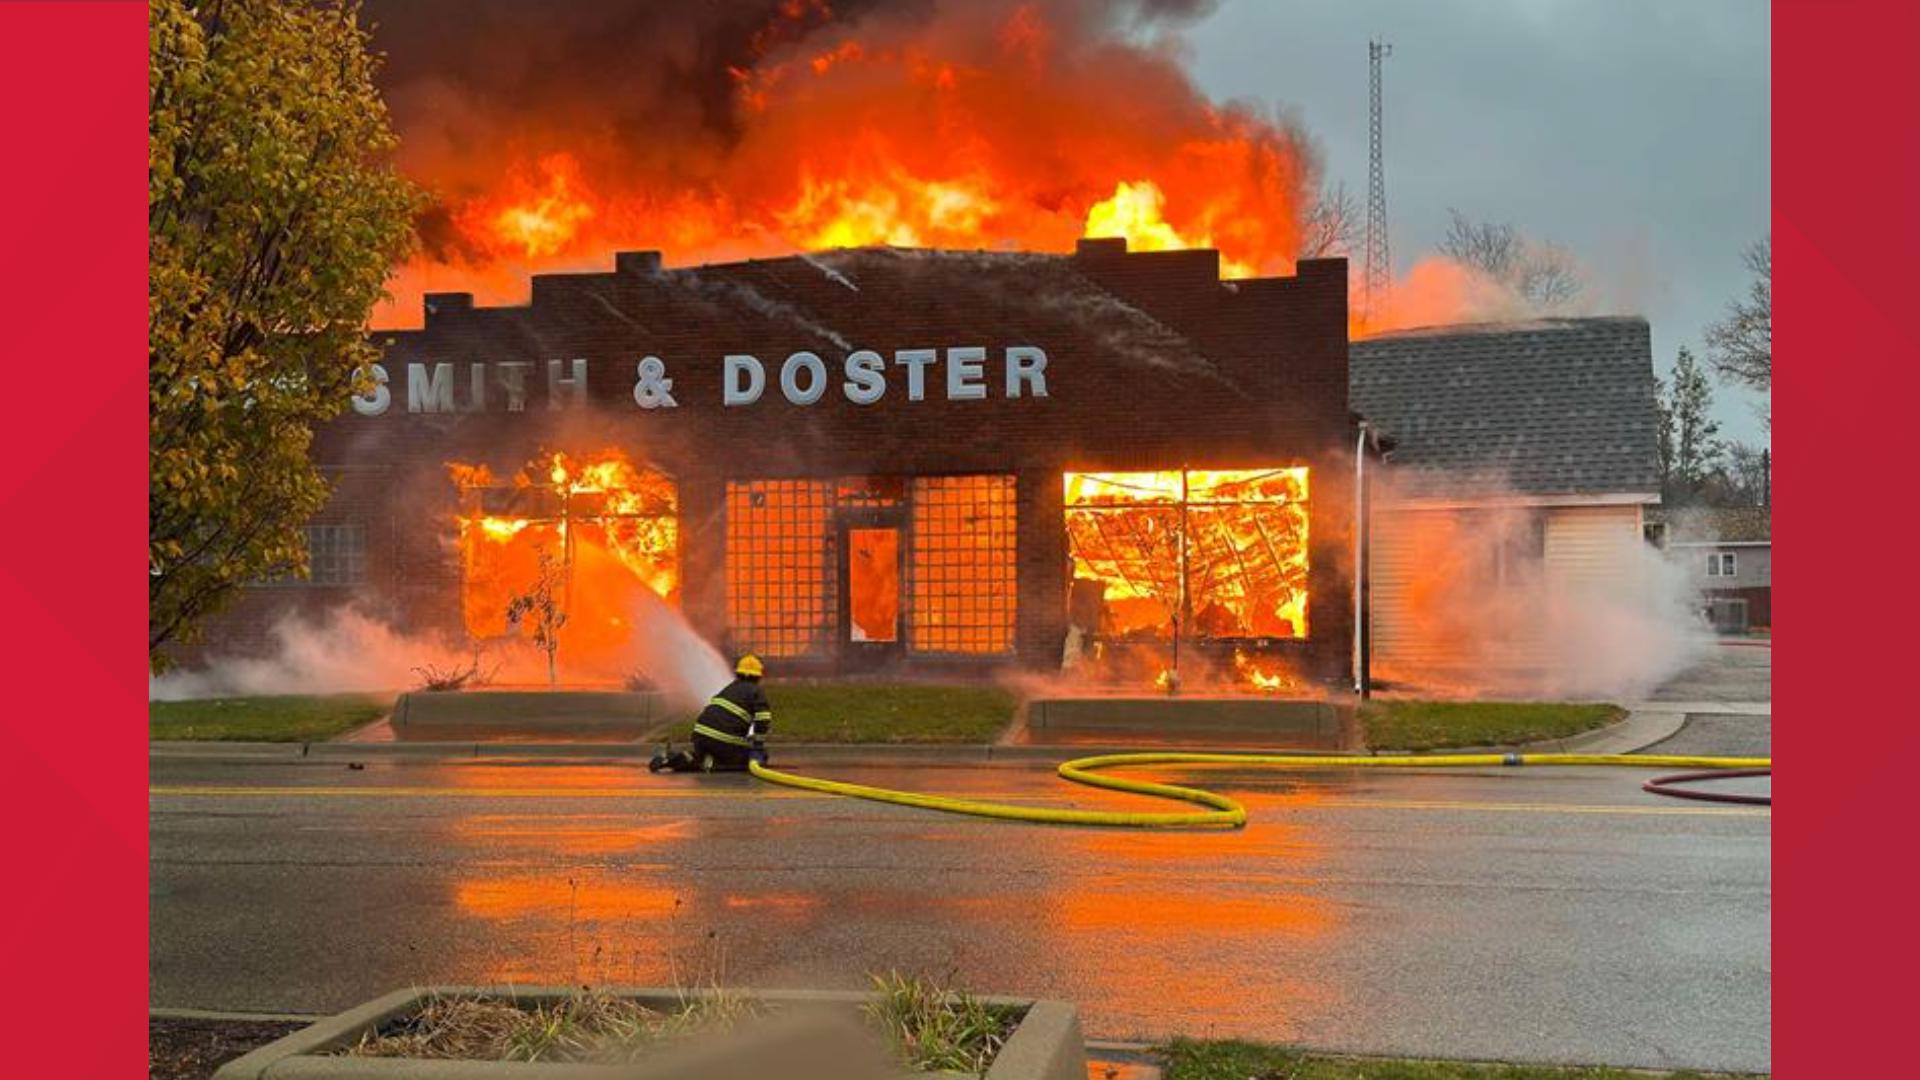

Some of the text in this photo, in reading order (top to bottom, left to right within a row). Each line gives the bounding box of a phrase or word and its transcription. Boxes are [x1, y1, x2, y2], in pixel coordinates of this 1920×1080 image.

[350, 358, 589, 416] SMITH
[632, 355, 679, 408] &
[723, 346, 1048, 406] DOSTER
